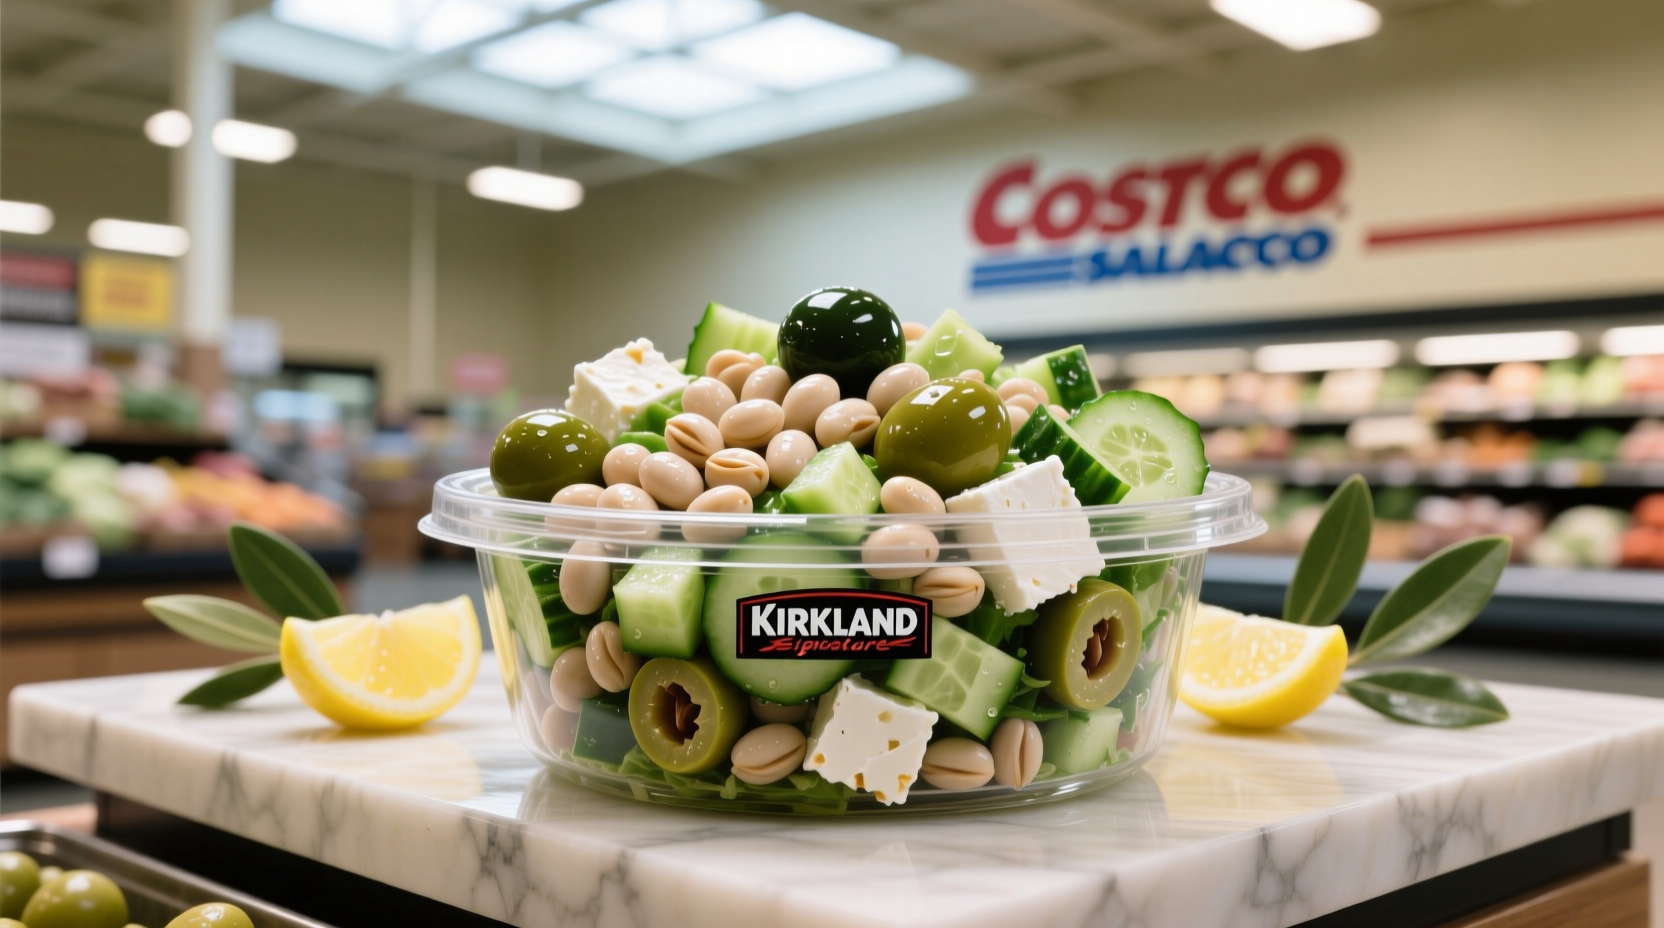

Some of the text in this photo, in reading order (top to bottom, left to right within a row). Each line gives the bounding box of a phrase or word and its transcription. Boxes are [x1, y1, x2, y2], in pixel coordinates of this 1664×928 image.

[970, 140, 1346, 248] COSTCO
[1088, 228, 1330, 284] SALACCO
[751, 603, 918, 637] KIRKLAND
